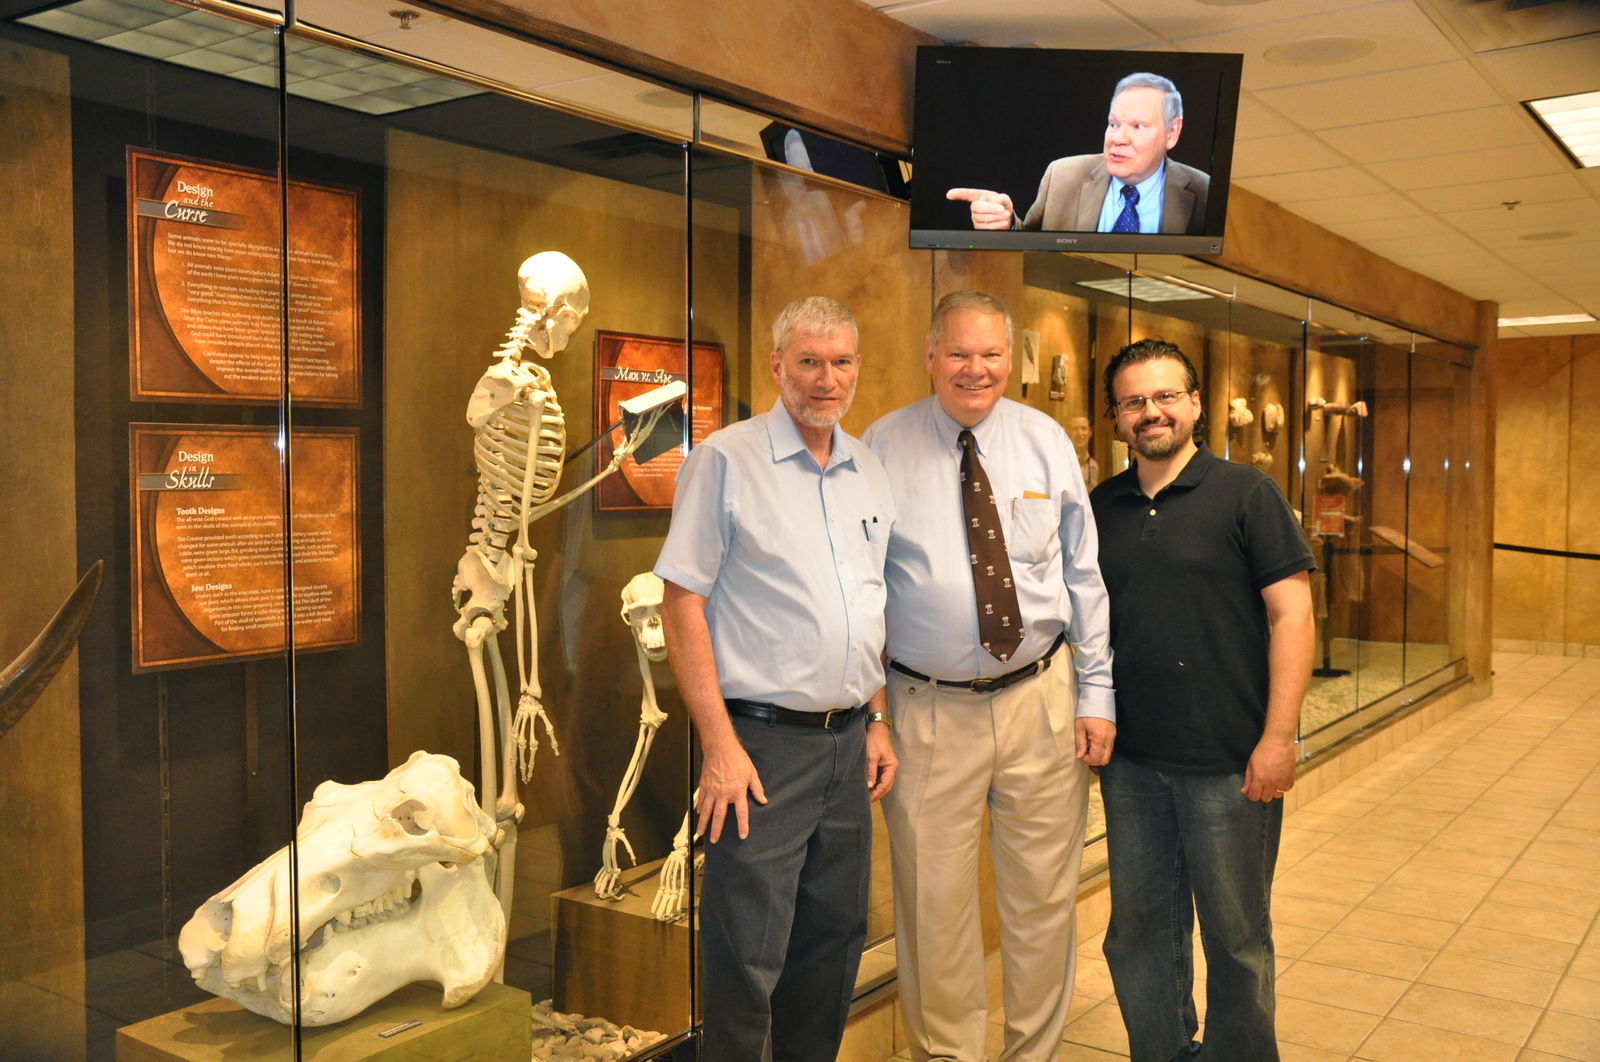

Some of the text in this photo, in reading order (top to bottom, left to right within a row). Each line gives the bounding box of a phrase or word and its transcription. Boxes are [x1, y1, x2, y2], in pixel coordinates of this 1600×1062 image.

[177, 180, 214, 198] Design
[183, 195, 214, 208] and the
[164, 199, 209, 223] Curse
[178, 450, 214, 464] Design
[164, 466, 215, 489] Skulls
[176, 506, 225, 516] Tooth Designs
[192, 582, 232, 593] Jaw Designs
